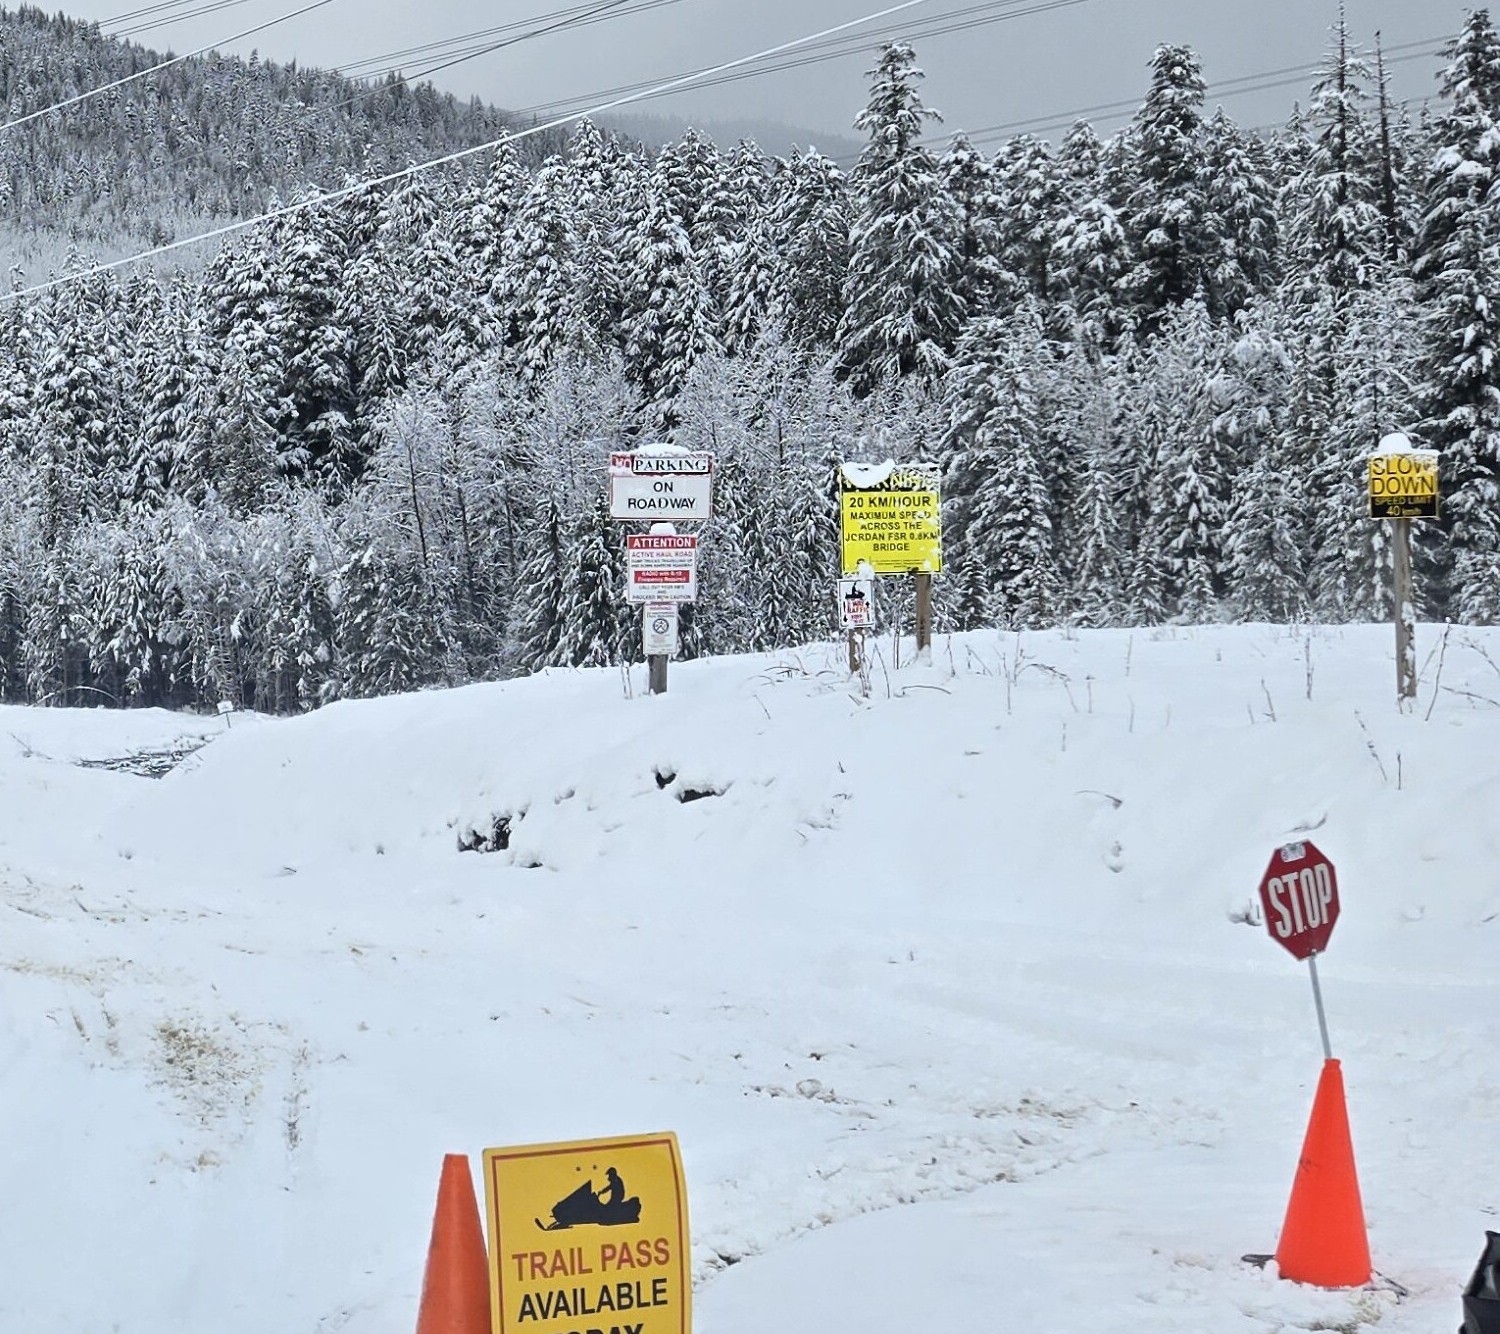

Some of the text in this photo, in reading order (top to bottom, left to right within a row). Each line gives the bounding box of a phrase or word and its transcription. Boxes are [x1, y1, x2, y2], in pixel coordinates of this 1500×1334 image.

[635, 460, 706, 471] PARKING
[653, 482, 673, 492] ON
[1372, 476, 1434, 494] DOWN
[628, 498, 695, 509] ROADWAY
[850, 497, 863, 507] 20
[1375, 496, 1406, 505] SPEED
[1386, 505, 1400, 516] 40
[888, 532, 907, 540] FSR
[633, 538, 691, 547] ATTENTION
[873, 543, 910, 551] BRIDGE
[1267, 863, 1332, 938] STOP
[511, 1237, 670, 1281] TRAIL PASS
[518, 1278, 668, 1322] AVAILABLE
